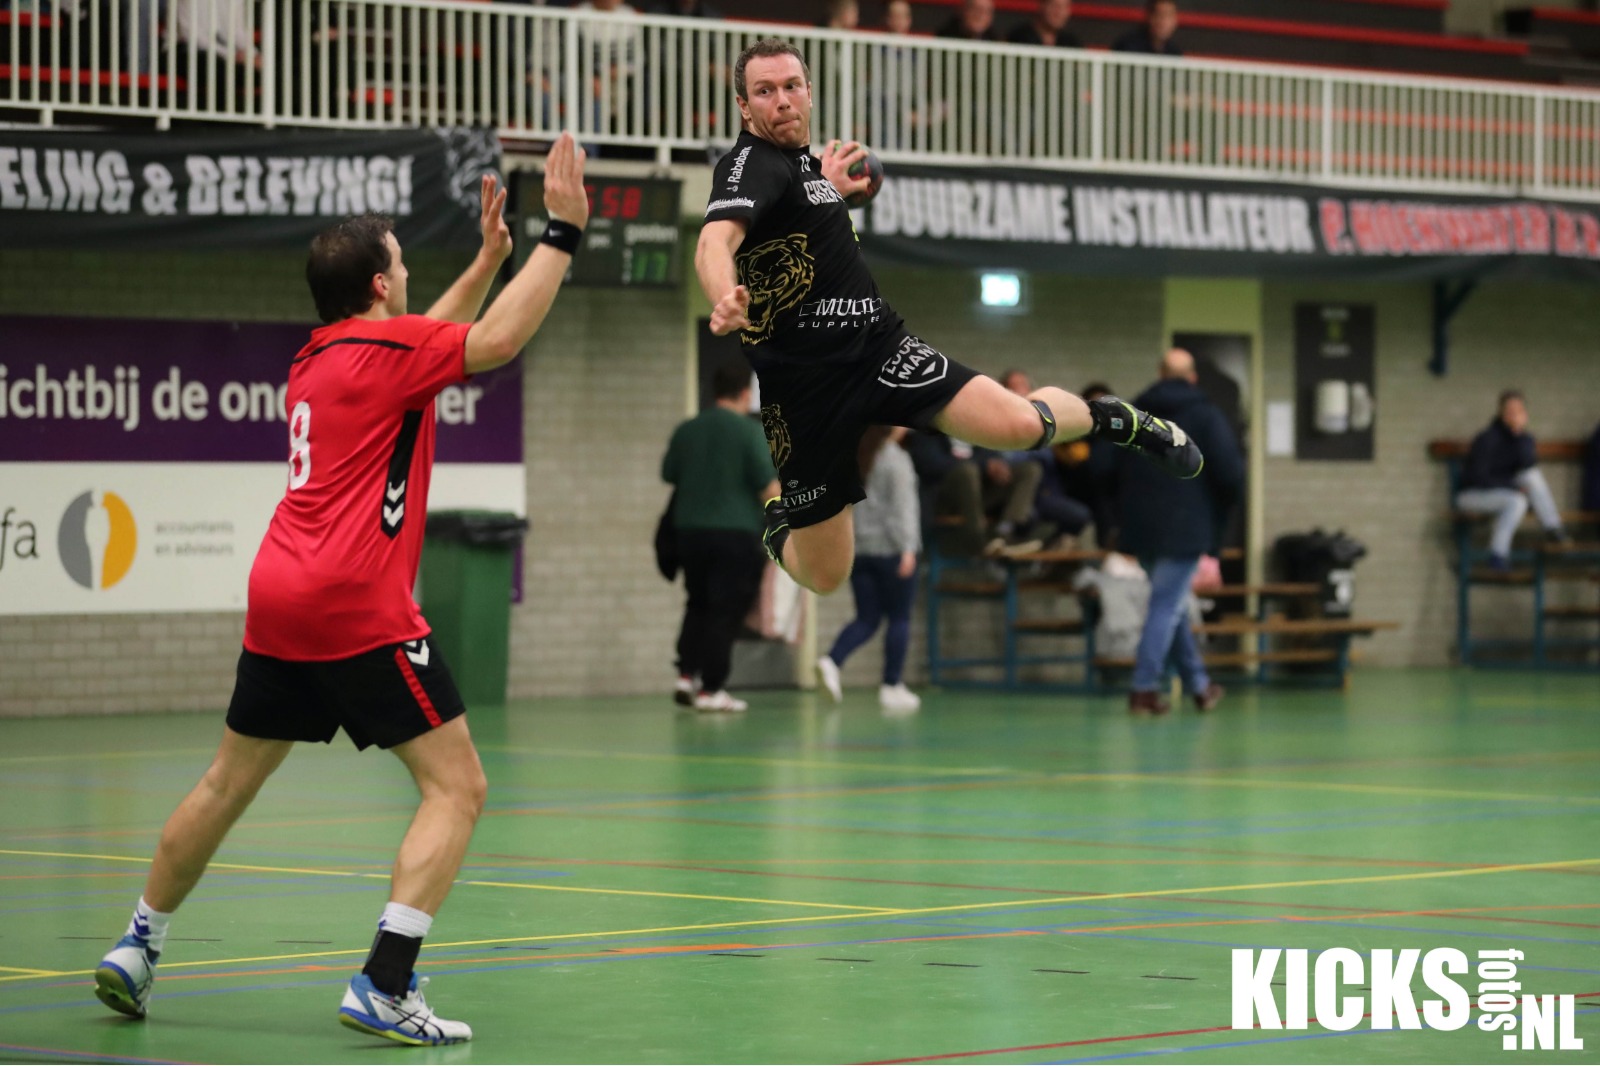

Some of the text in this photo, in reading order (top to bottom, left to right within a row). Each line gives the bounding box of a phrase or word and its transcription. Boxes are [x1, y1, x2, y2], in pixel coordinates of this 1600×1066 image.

[0, 146, 414, 216] ELING & BELEVING!
[727, 145, 753, 184] Rabobank
[871, 176, 1072, 244] DUURZAME
[1072, 185, 1314, 254] INSTALLATEUR
[815, 297, 875, 317] MULTI
[0, 364, 141, 432] ichtbij
[152, 366, 210, 421] de
[898, 348, 935, 381] MAN
[289, 401, 311, 491] 8
